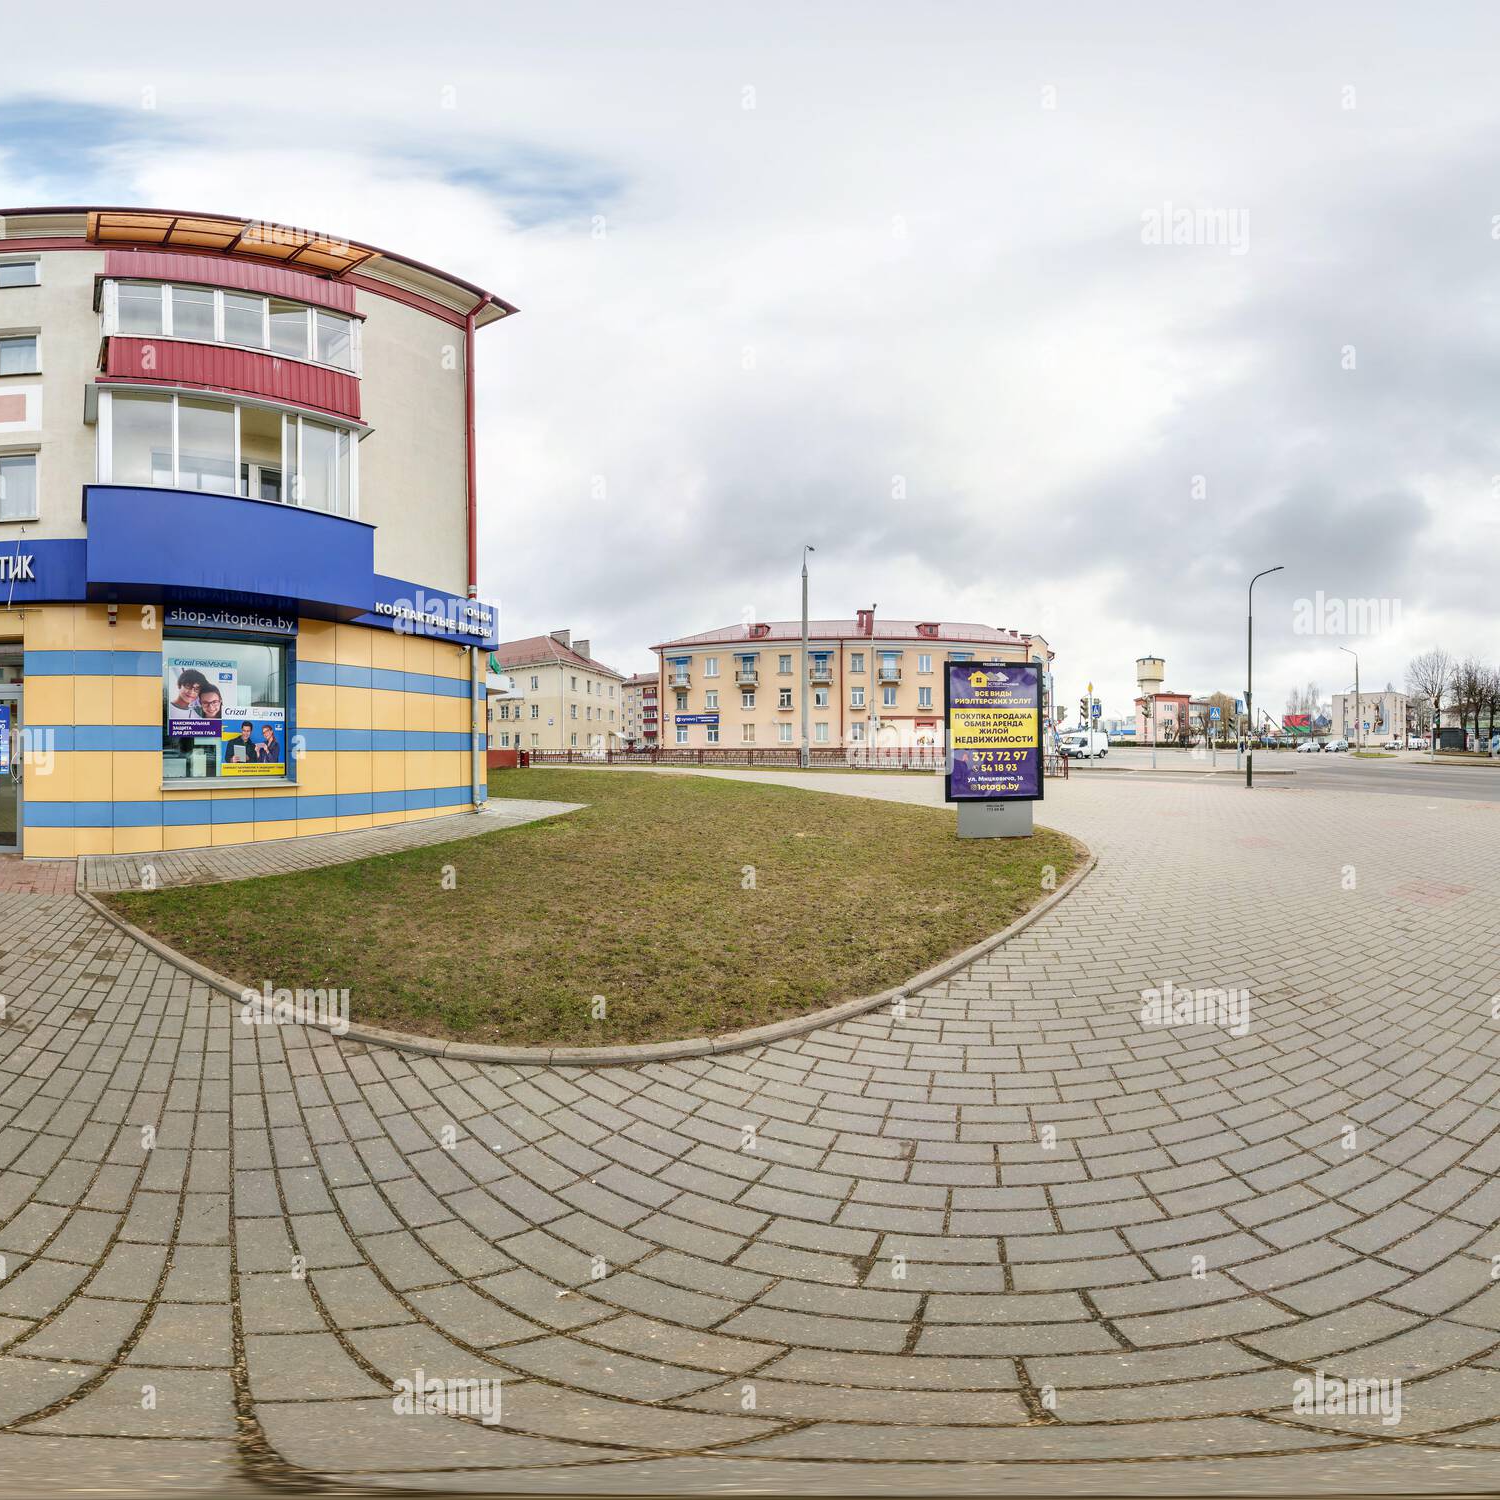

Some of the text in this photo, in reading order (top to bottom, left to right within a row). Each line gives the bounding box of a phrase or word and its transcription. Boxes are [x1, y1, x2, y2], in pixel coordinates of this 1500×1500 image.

[466, 607, 492, 622] ОЧКИ
[171, 608, 294, 632] shop-vitoptica.by
[375, 602, 493, 638] КОНТАКТНЫЕ ЛИНЗЫ
[174, 658, 195, 667] Crizal
[224, 707, 247, 716] Crizal
[979, 727, 1009, 735] ЖИЛОЙ
[955, 736, 1034, 744] НЕДВИЖИМОСТИ
[972, 751, 1028, 761] 373 72 97
[981, 764, 993, 772] 54
[994, 764, 1004, 772] 18
[977, 783, 1020, 791] 1etage.by
